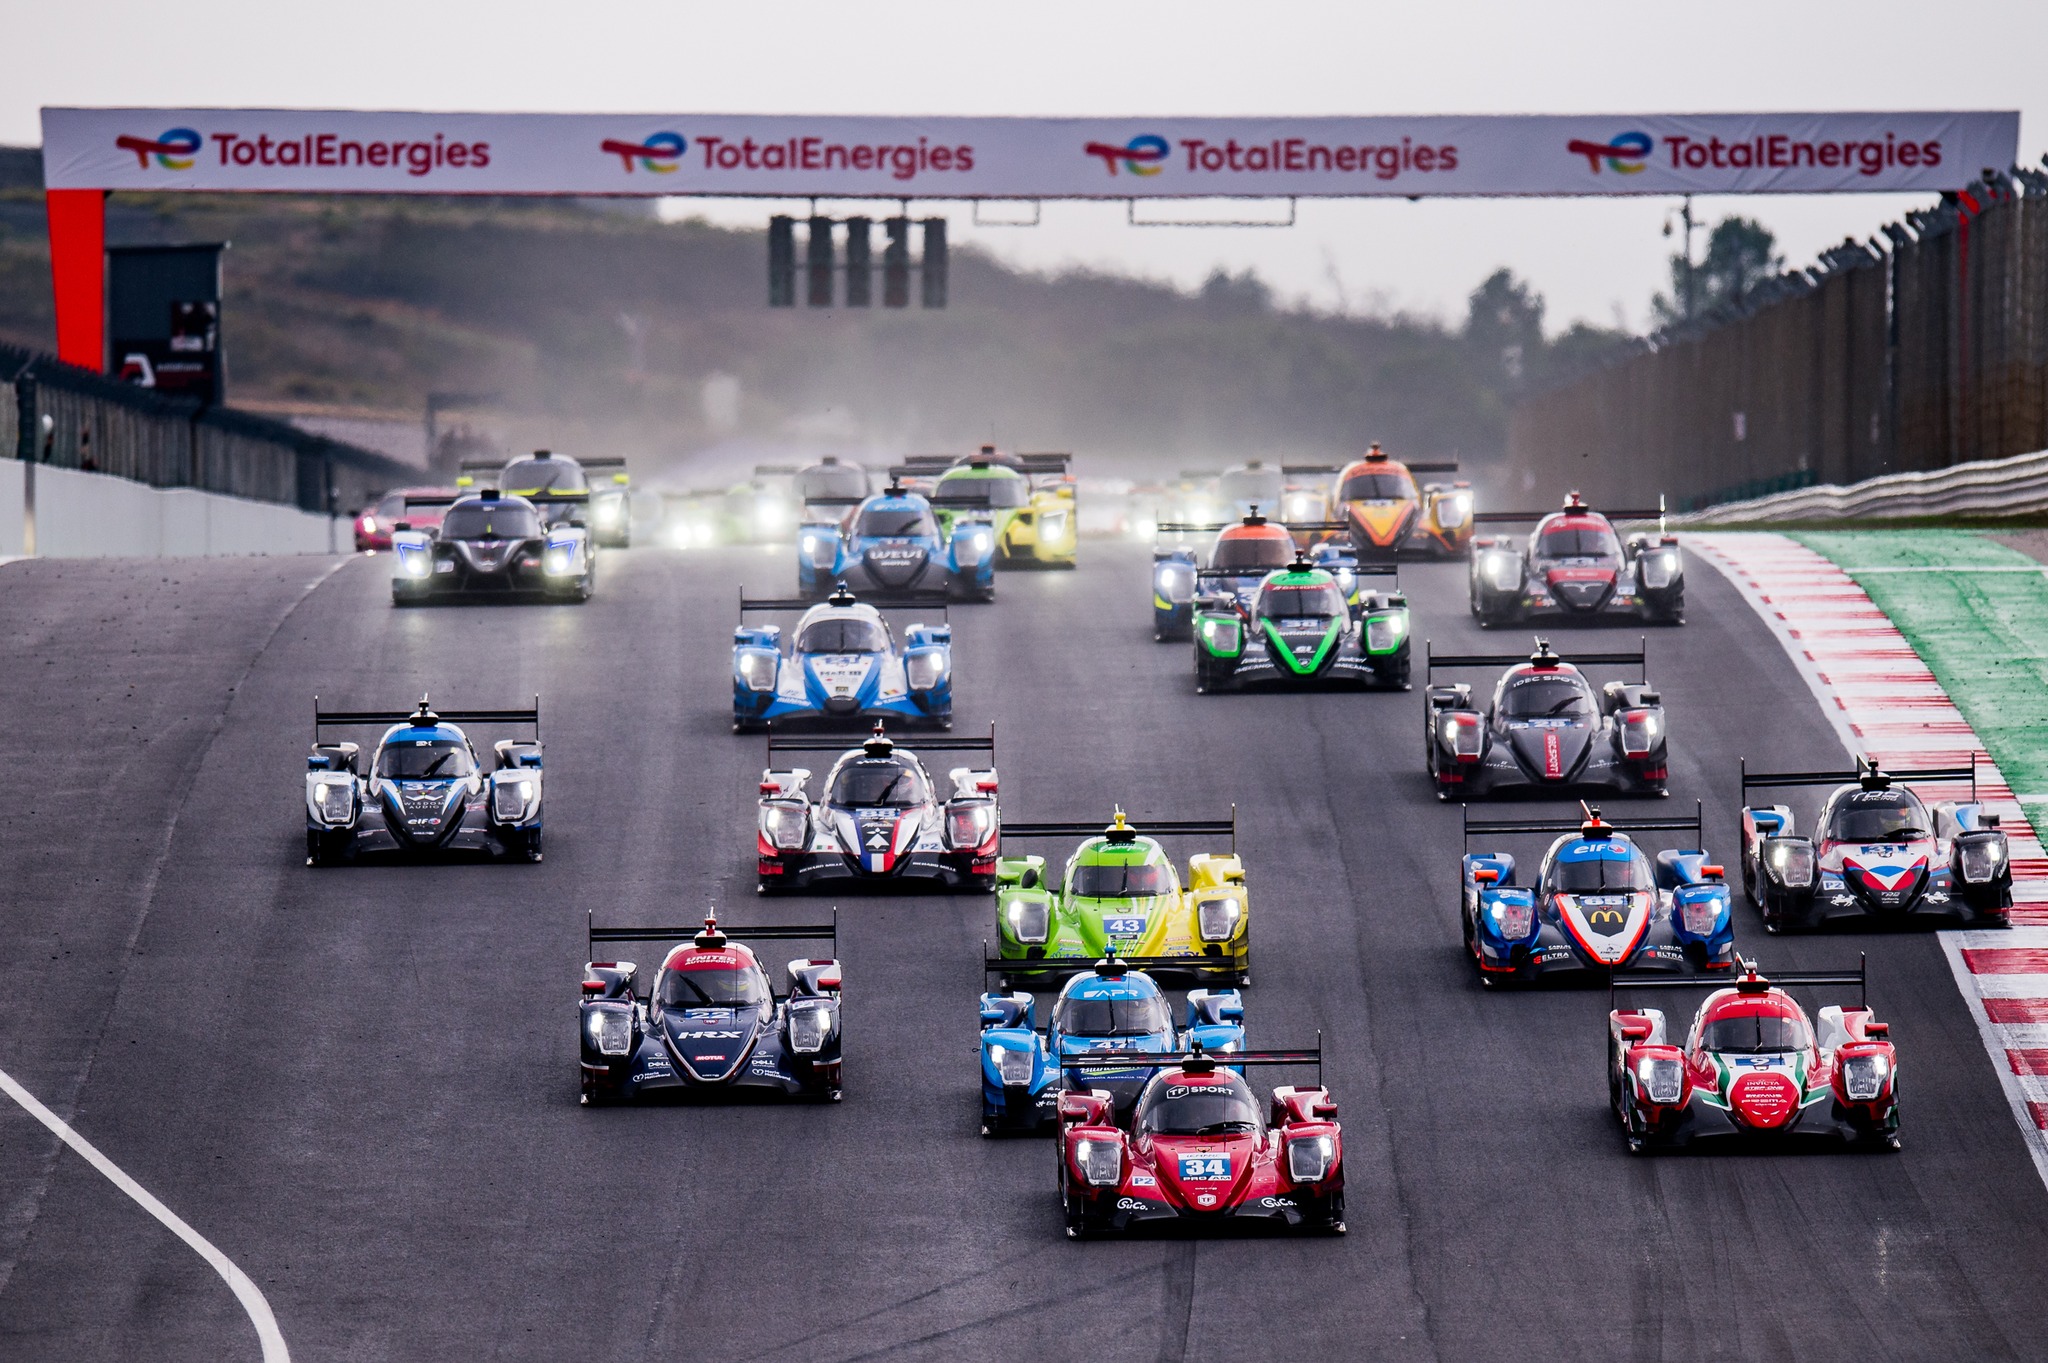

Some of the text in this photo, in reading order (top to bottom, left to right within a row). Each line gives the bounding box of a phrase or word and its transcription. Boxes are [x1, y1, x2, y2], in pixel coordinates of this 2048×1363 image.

[210, 133, 491, 177] TotalEnergies
[696, 136, 975, 180] TotalEnergies
[1179, 136, 1459, 180] TotalEnergies
[1663, 132, 1942, 176] TotalEnergies
[1513, 676, 1541, 688] IDEC
[406, 783, 442, 791] 37
[1573, 844, 1606, 854] elf
[1110, 920, 1140, 932] 43
[1542, 952, 1570, 963] ELTRA
[1656, 951, 1684, 960] ELTRA
[1095, 989, 1139, 998] APR
[690, 1011, 731, 1019] 22
[678, 1031, 743, 1039] HRX
[1096, 1041, 1130, 1049] 47
[1170, 1086, 1235, 1096] TF SPORT
[1185, 1159, 1225, 1175] 34
